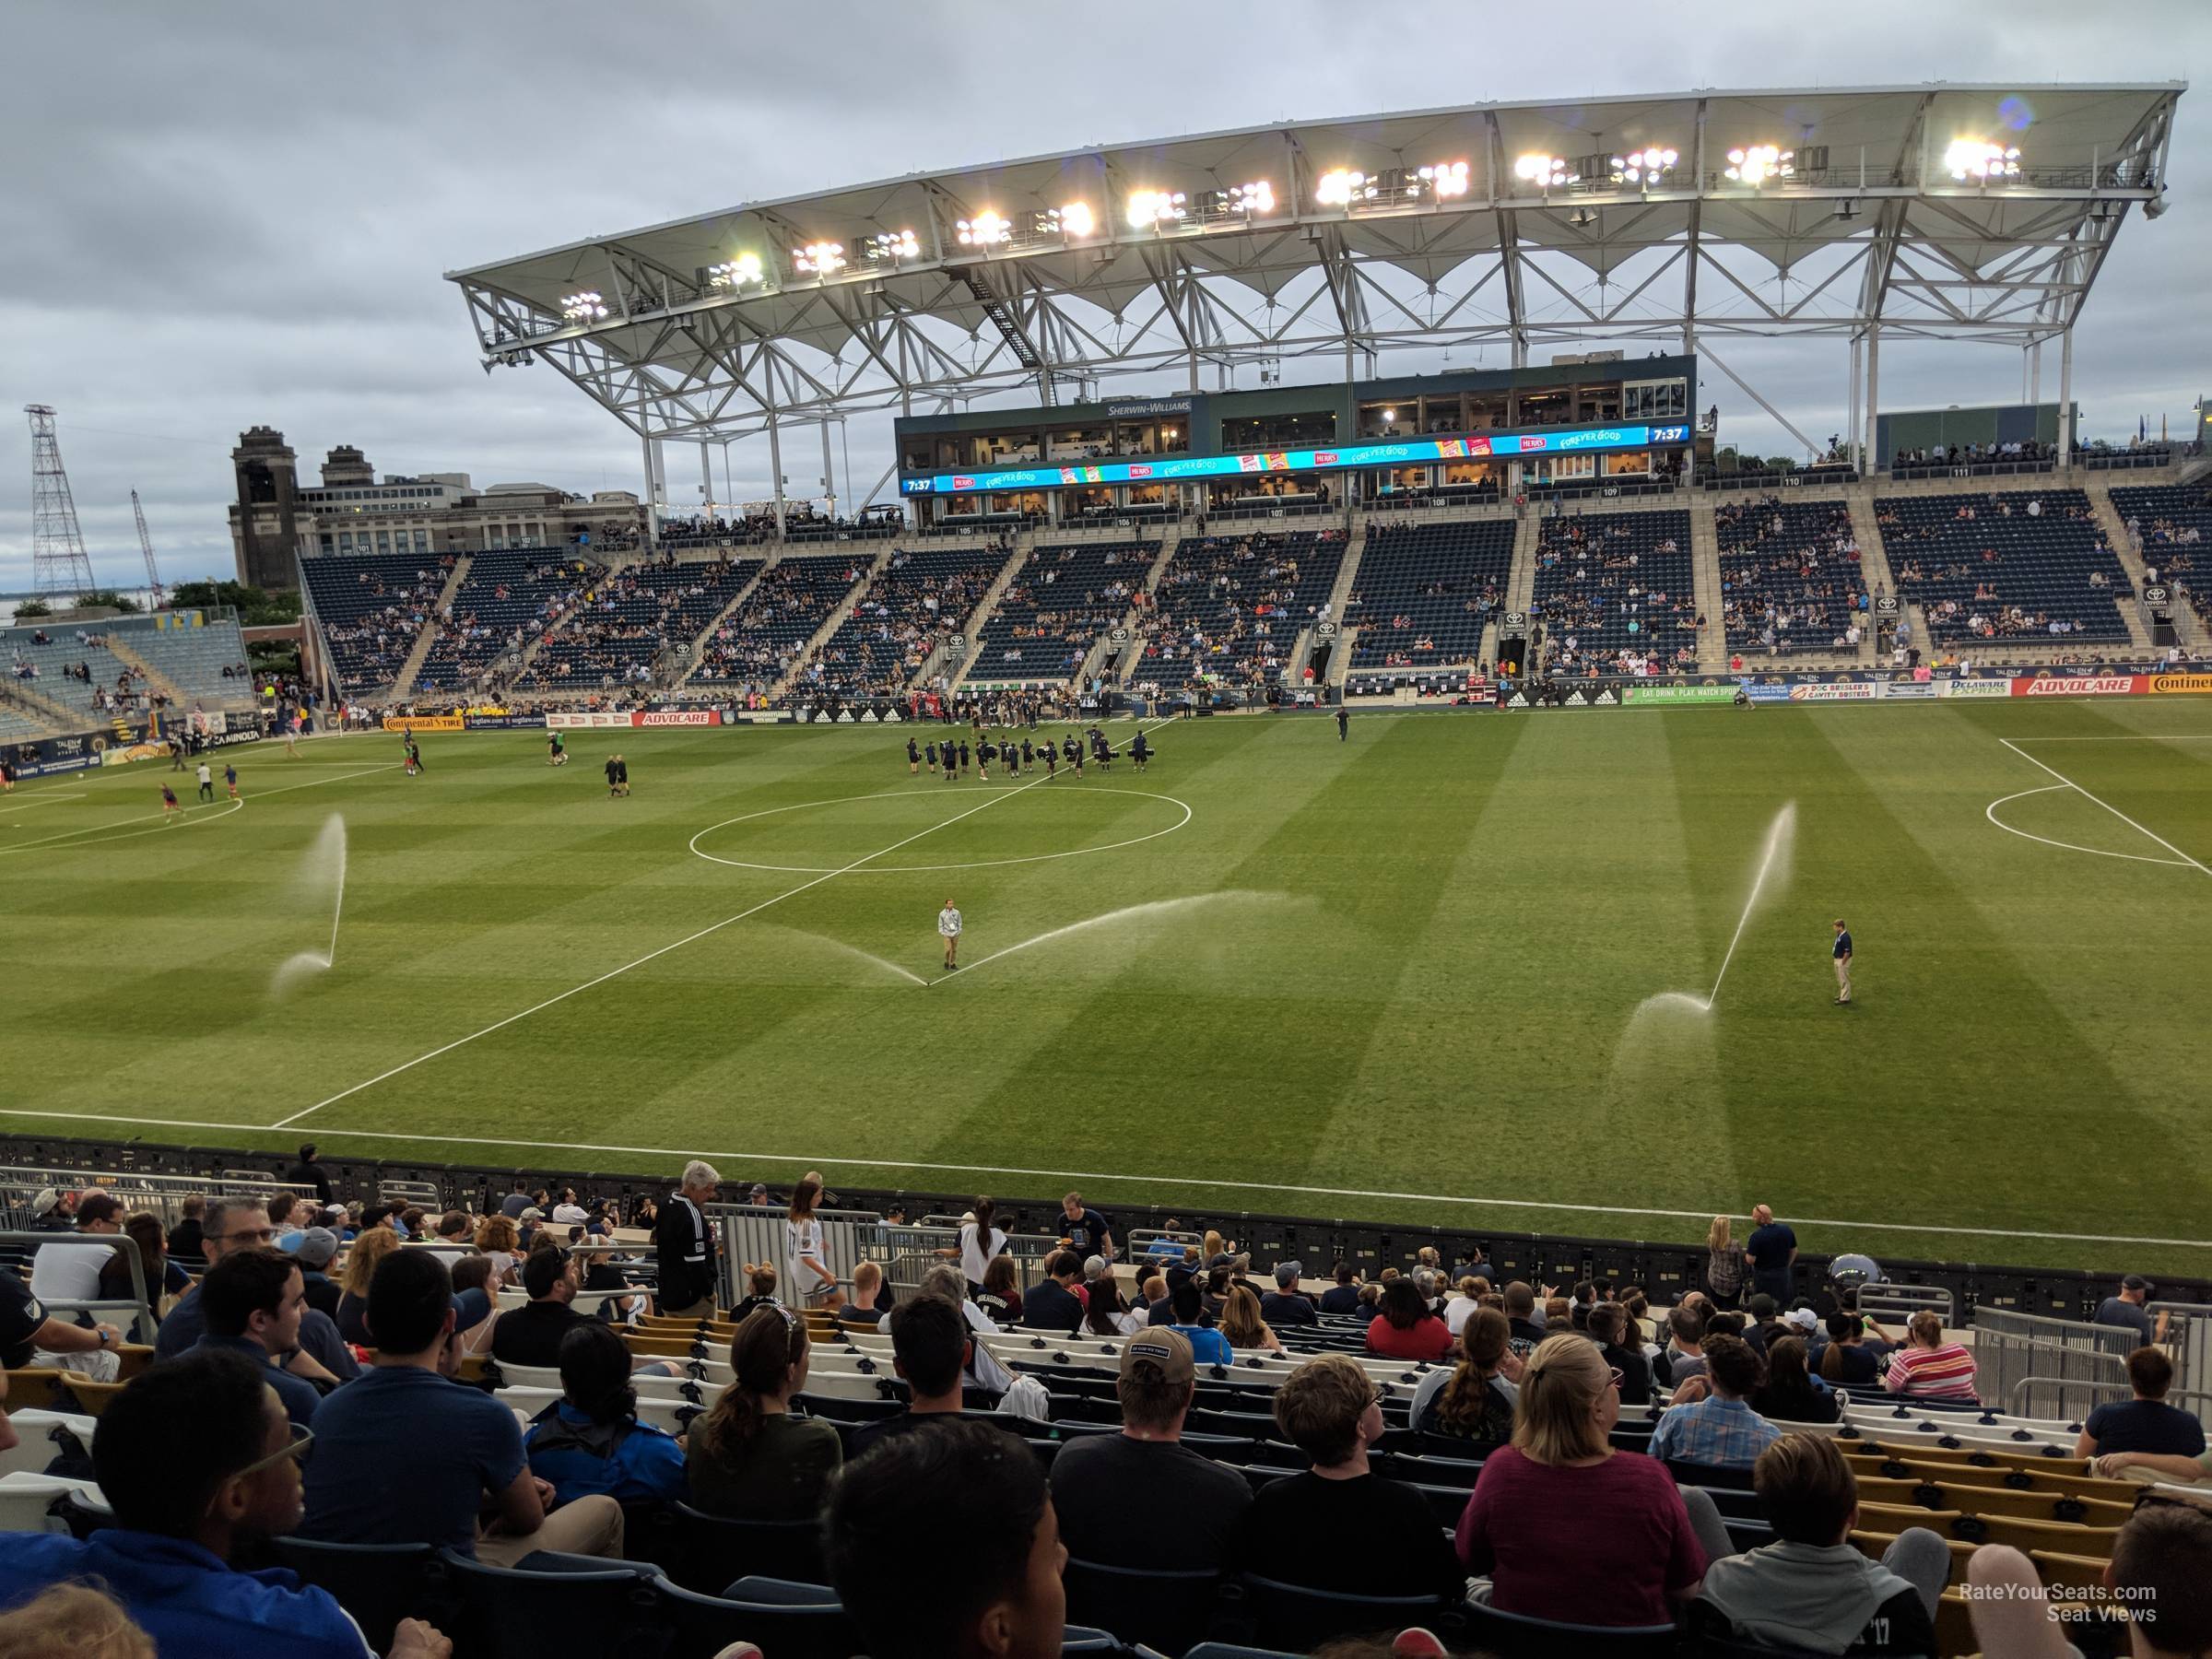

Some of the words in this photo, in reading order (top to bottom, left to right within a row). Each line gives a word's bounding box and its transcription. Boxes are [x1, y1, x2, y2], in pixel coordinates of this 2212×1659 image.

[1108, 402, 1191, 416] SHERWIN-WILLIAMS
[1559, 433, 1595, 449] FOREVER
[1597, 430, 1621, 441] GOOD
[1653, 428, 1683, 441] 7:37
[1385, 445, 1408, 455] GOOD
[1954, 468, 1969, 477] 111
[908, 479, 930, 491] 7:37
[985, 474, 1016, 488] FOREVER
[1016, 471, 1036, 481] GOOD
[1784, 477, 1800, 486] 110
[1604, 488, 1618, 497] 109
[1432, 499, 1446, 507] 108
[1271, 509, 1283, 517] 107
[1118, 518, 1130, 526] 106
[2030, 677, 2131, 692] ADVOCARE
[2154, 677, 2212, 691] Contine
[1950, 688, 2006, 696] EXPRESS
[644, 712, 709, 724] ADVOCARE
[386, 718, 433, 731] Continental
[442, 719, 462, 727] TIRE
[226, 730, 259, 744] MINOLTA
